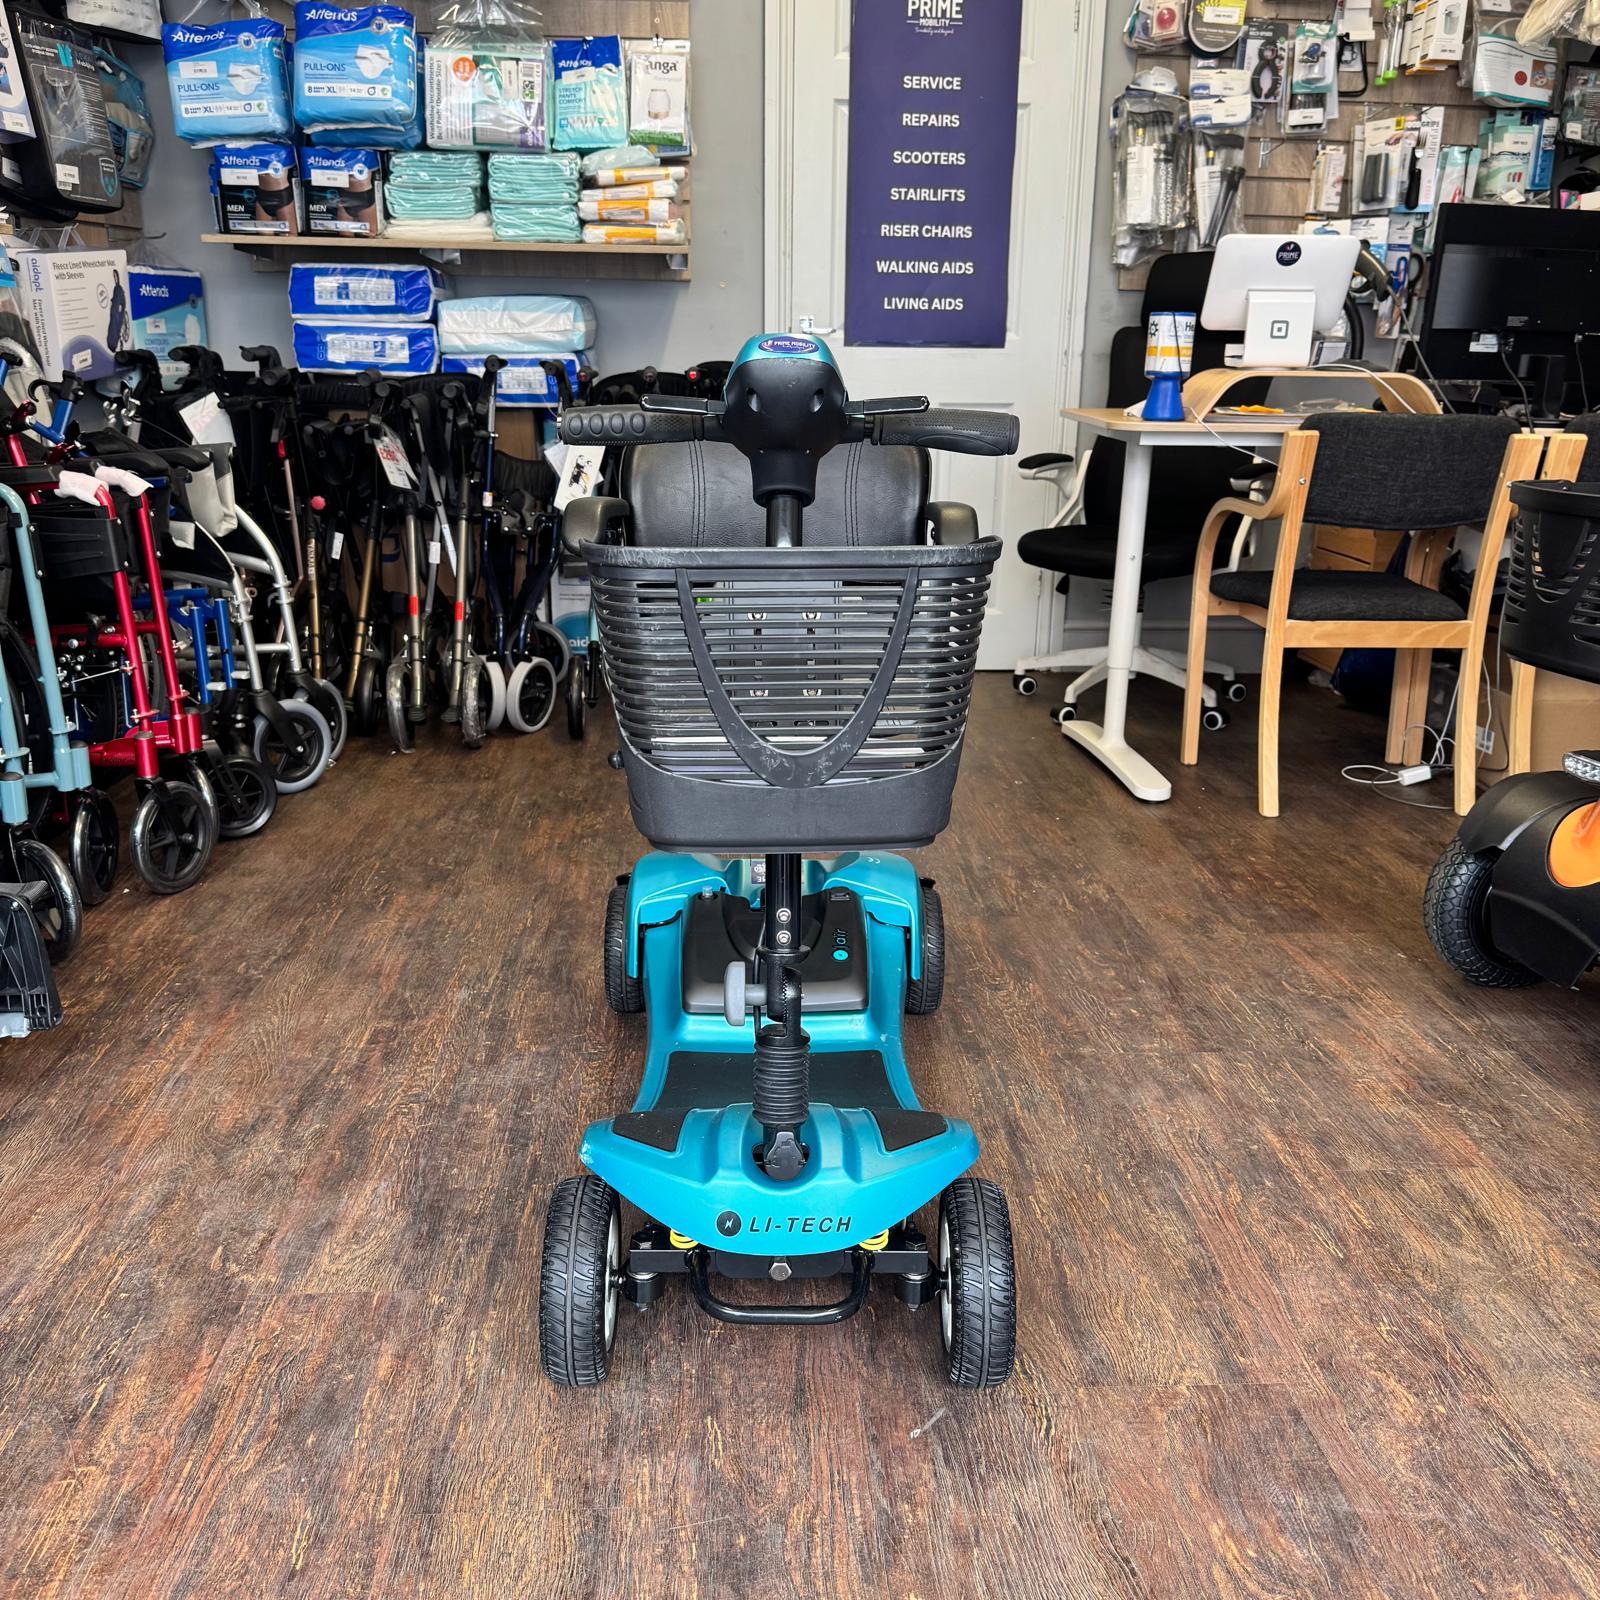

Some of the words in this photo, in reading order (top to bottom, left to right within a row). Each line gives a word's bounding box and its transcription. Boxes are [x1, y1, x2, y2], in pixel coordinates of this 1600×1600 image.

[304, 8, 358, 21] Attends
[907, 0, 963, 18] PRIME
[919, 18, 951, 27] MOBILITY
[170, 30, 225, 43] Attends
[303, 62, 346, 72] PULL-ONS
[177, 82, 220, 93] PULL-ONS
[326, 85, 337, 93] XL
[903, 75, 962, 90] SERVICE
[902, 113, 960, 127] REPAIRS
[221, 155, 261, 166] Attends
[306, 155, 346, 167] Attends
[892, 150, 966, 165] SCOOTERS
[890, 187, 966, 202] STAIRLIFTS
[226, 204, 245, 212] MEN
[309, 204, 327, 212] MEN
[880, 224, 919, 237] RISER
[922, 225, 973, 239] CHAIRS
[876, 260, 939, 274] WALKING
[941, 261, 974, 275] AIDS
[139, 284, 170, 297] Attends
[884, 297, 929, 310] LIVING
[931, 298, 964, 311] AIDS
[750, 1216, 851, 1233] LI-TECH
